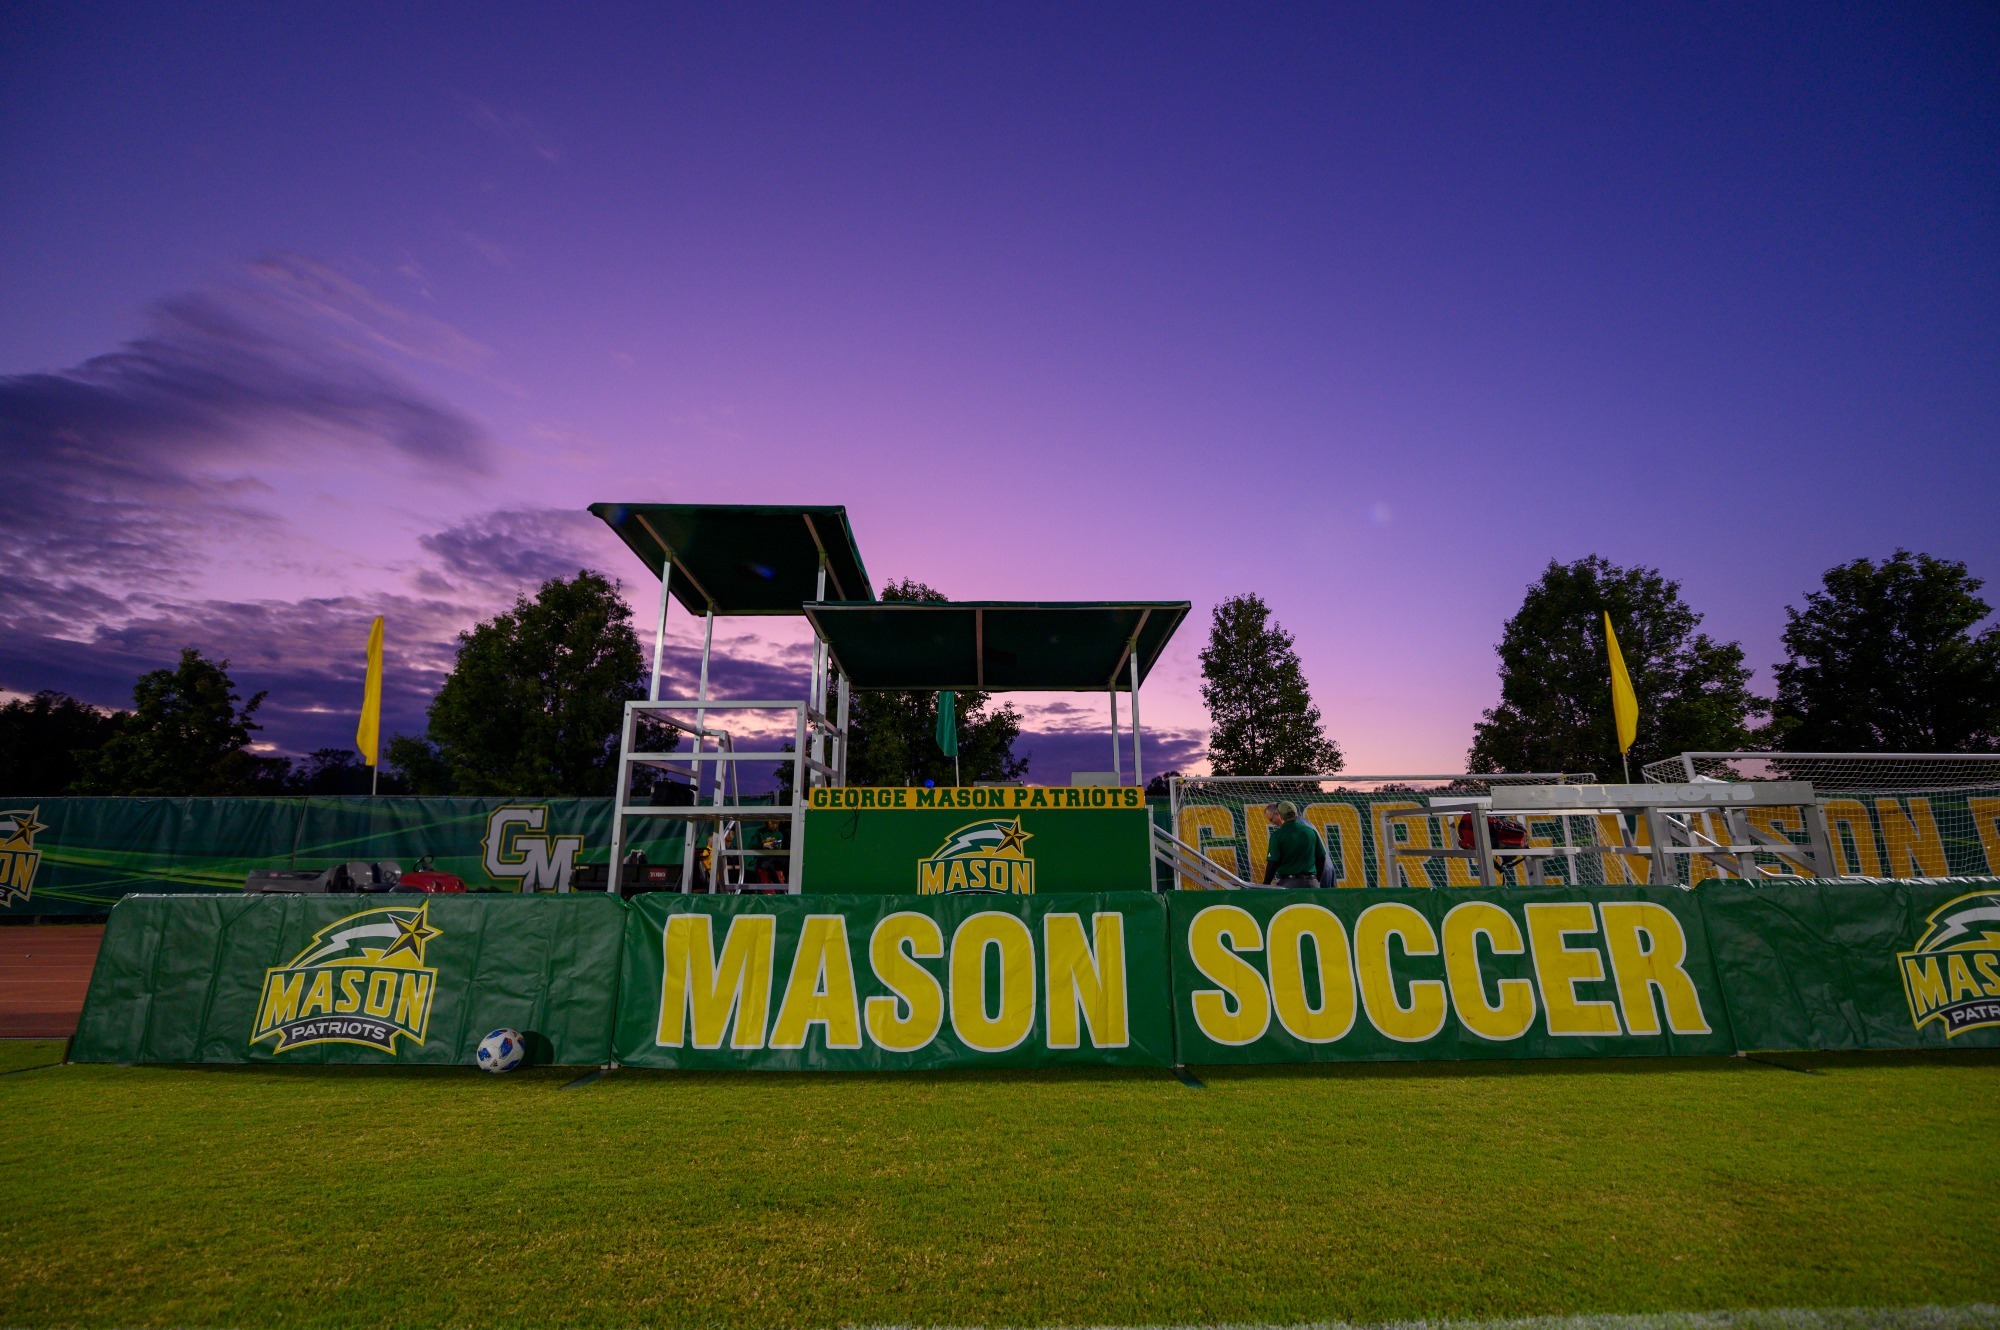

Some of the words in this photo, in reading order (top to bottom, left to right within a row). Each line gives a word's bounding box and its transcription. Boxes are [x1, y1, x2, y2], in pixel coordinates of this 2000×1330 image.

[813, 788, 907, 808] GEORGE
[915, 788, 1005, 807] MASON
[1013, 788, 1138, 808] PATRIOTS
[480, 805, 584, 893] GM
[921, 859, 1031, 896] MASON
[259, 969, 430, 1034] MASON
[655, 910, 1130, 1052] MASON
[1187, 900, 1713, 1046] SOCCER
[291, 1021, 387, 1040] PATRIOTS
